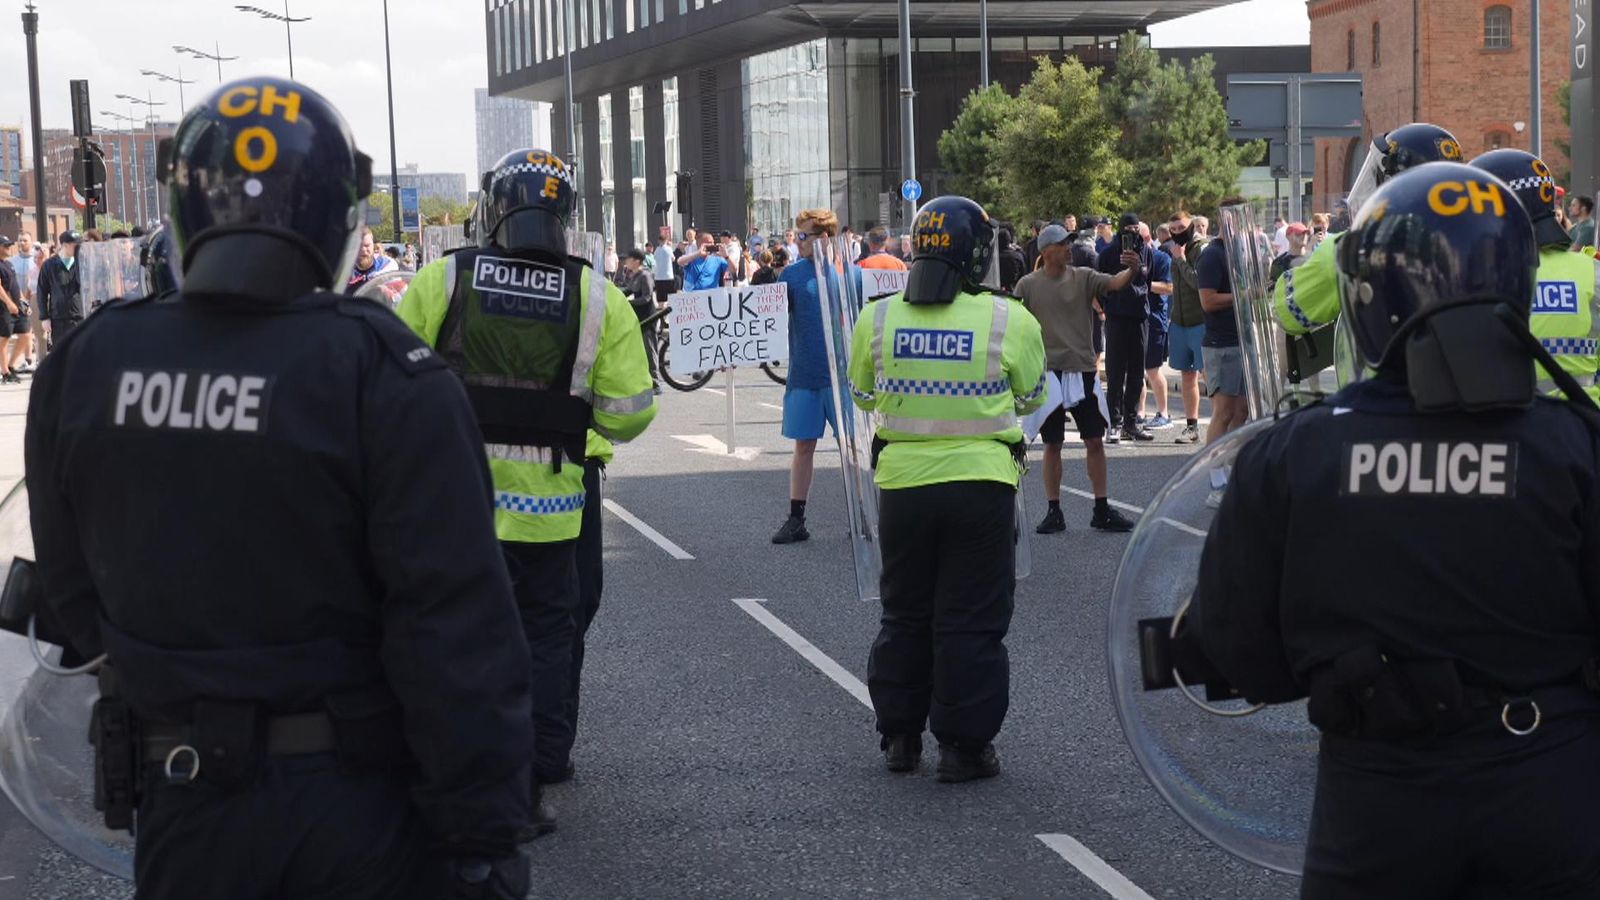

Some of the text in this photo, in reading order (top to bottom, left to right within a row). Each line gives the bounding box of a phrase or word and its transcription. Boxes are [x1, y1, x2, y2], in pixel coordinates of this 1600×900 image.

[218, 86, 302, 123] CH
[526, 151, 564, 171] CH
[1531, 159, 1549, 177] C
[544, 177, 561, 200] E
[1427, 180, 1506, 217] CH
[917, 210, 946, 230] CH
[479, 262, 560, 292] POLICE
[872, 272, 898, 291] YOU
[707, 291, 759, 321] UK
[1532, 284, 1575, 308] ICE
[680, 318, 777, 346] BORDER
[896, 332, 970, 357] POLICE
[698, 339, 770, 368] FARCE
[114, 371, 266, 432] POLICE
[1349, 442, 1508, 495] POLICE
